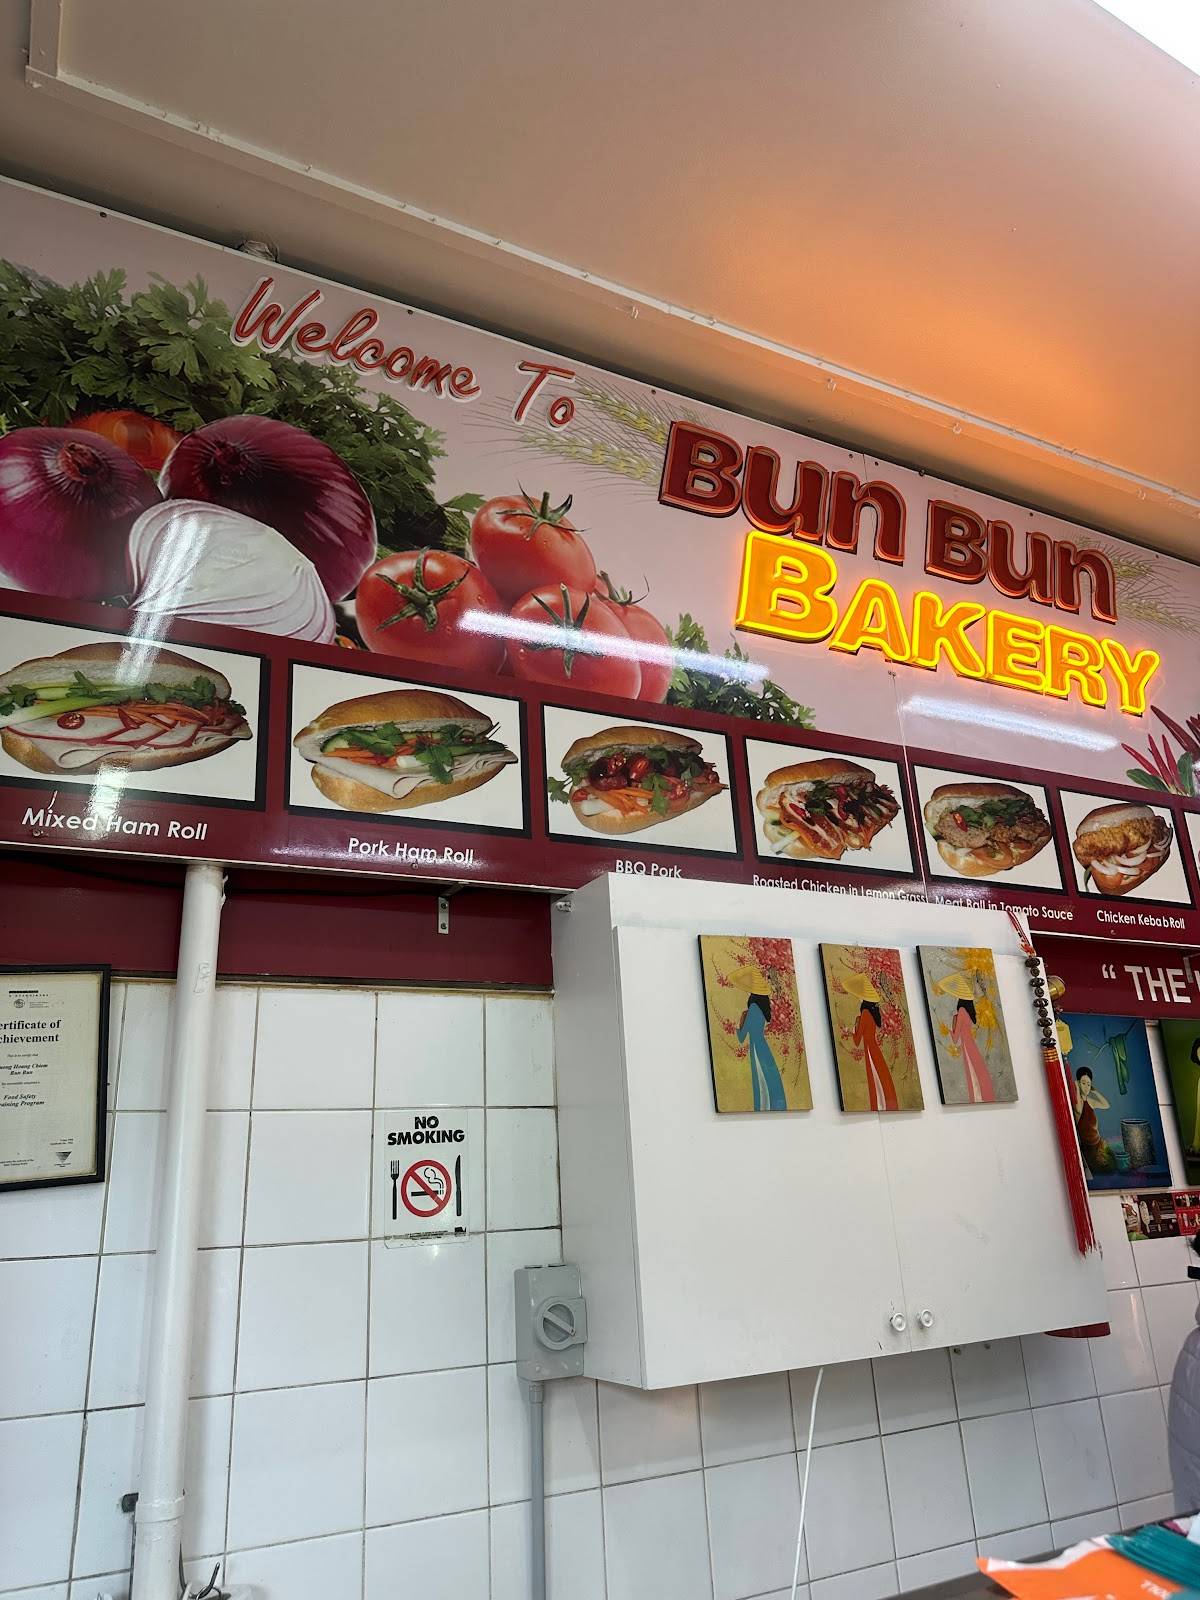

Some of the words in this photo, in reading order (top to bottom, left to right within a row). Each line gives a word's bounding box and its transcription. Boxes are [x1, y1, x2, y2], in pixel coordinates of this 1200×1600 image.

[230, 276, 481, 400] Welcome
[514, 360, 576, 431] To
[657, 420, 906, 567] Bun
[924, 499, 1118, 624] Bun
[733, 530, 1162, 716] BAKERY
[21, 807, 98, 832] Mixed
[105, 815, 160, 836] Ham
[167, 820, 208, 841] Roll
[348, 837, 391, 857] Pork
[395, 842, 437, 861] Ham
[443, 846, 474, 864] Roll
[615, 859, 646, 875] BBQ
[650, 863, 682, 878] Pork
[752, 874, 798, 890] Roasted
[801, 879, 846, 894] Chicken
[848, 883, 858, 897] in
[1000, 902, 1039, 917] Tomato
[1041, 906, 1073, 921] Sauce
[1096, 909, 1136, 925] Chicken
[1169, 917, 1186, 930] Roll
[49, 1019, 62, 1029] of
[414, 1115, 440, 1130] NO
[387, 1129, 465, 1146] SMOKING
